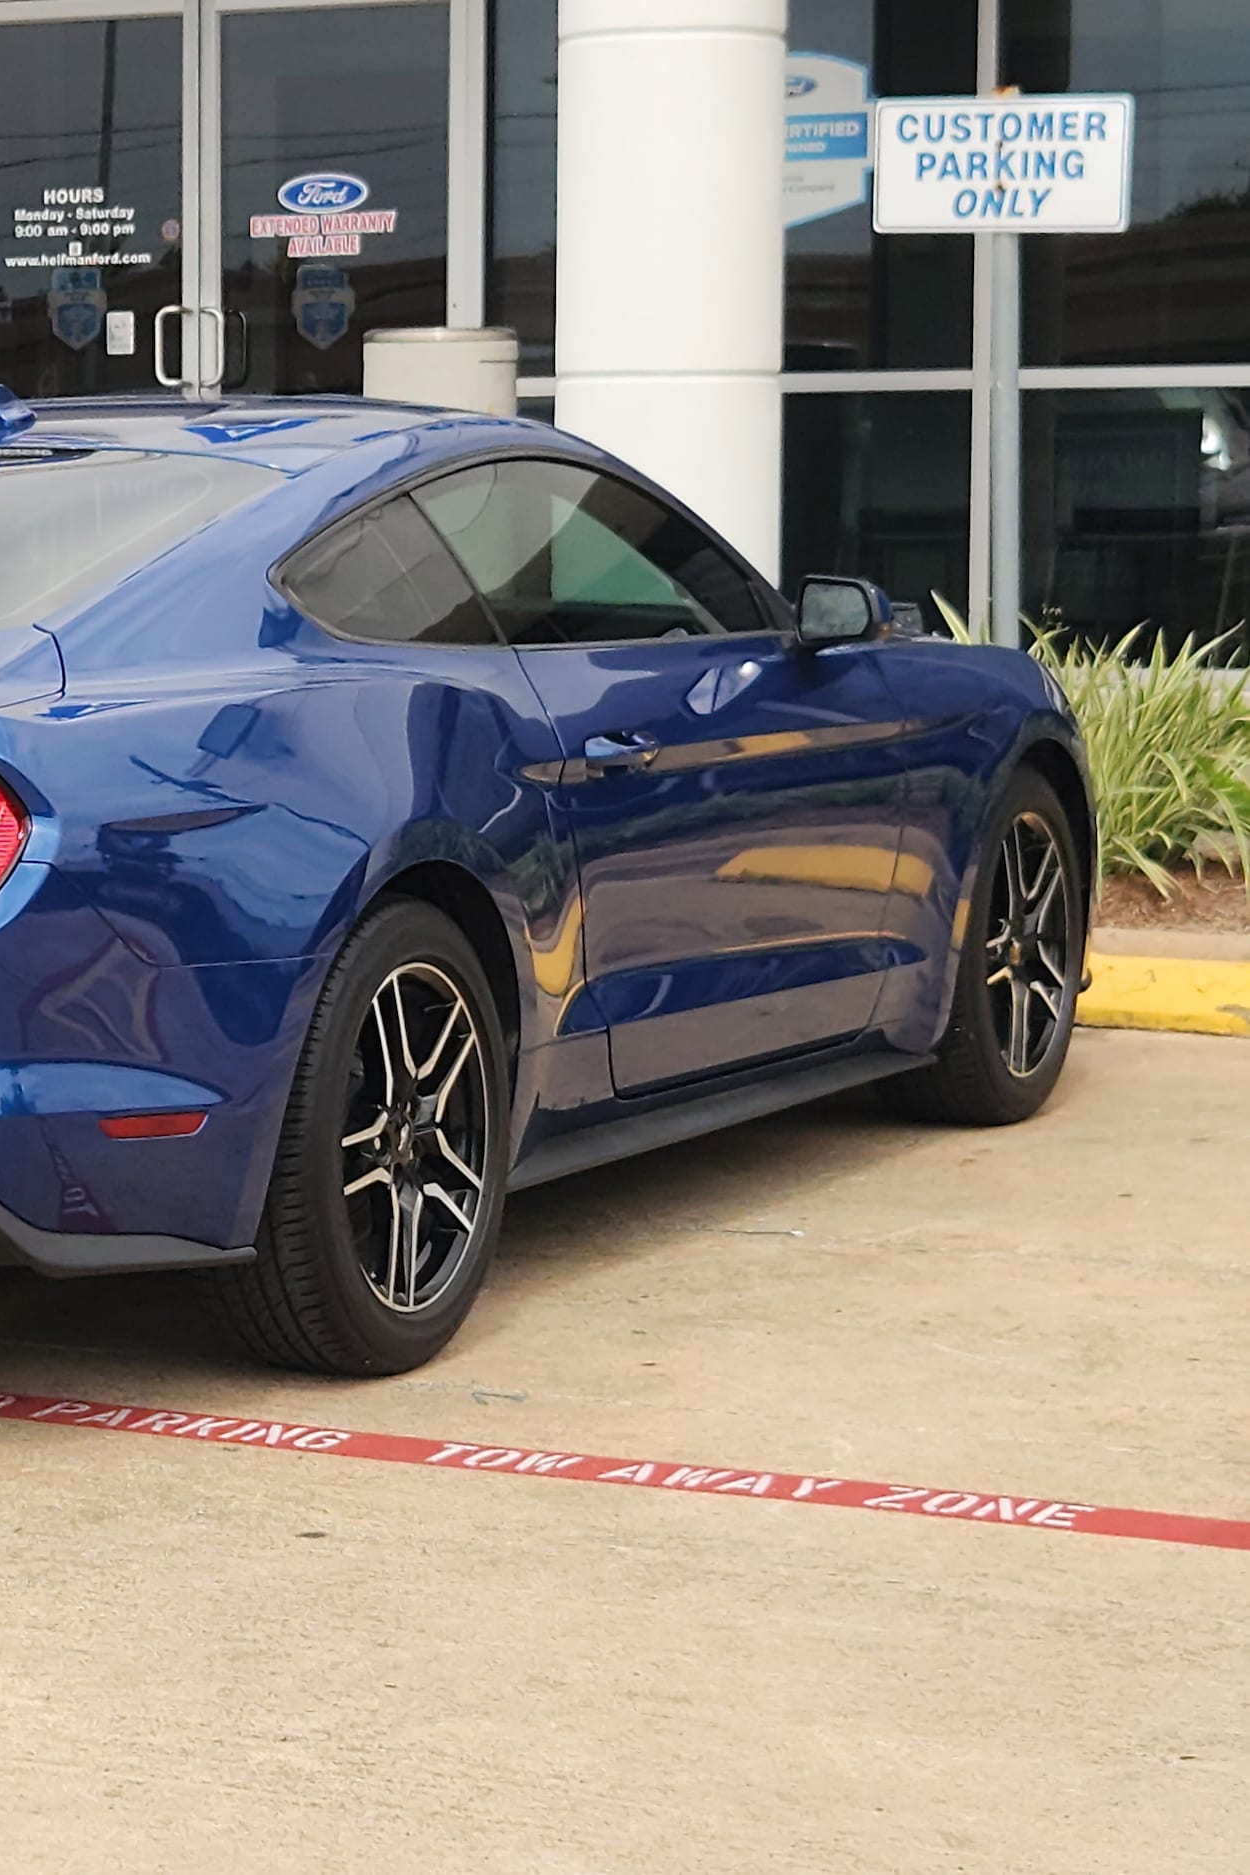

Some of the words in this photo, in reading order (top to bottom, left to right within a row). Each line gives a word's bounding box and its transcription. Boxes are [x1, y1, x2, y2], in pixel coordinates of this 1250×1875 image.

[784, 121, 860, 138] RTIFIED
[896, 112, 1107, 143] CUSTOMER
[915, 150, 1085, 180] PARKING
[43, 187, 104, 205] HOURS
[297, 181, 350, 206] Ford
[952, 188, 1052, 219] ONLY
[14, 208, 65, 223] Monday
[75, 205, 135, 221] Saturday
[250, 215, 320, 238] EXTENDED
[321, 210, 397, 235] WARRANTY
[14, 224, 43, 238] 9:00
[47, 226, 69, 237] am
[79, 223, 109, 236] 9:00
[113, 223, 135, 237] pm
[287, 234, 360, 258] AVAILABLE
[5, 252, 152, 268] www.helfmanford.com
[30, 1401, 352, 1450] PARKING
[425, 1443, 583, 1473] TOW
[597, 1462, 842, 1499] AWAY
[863, 1486, 1097, 1527] ZONE
